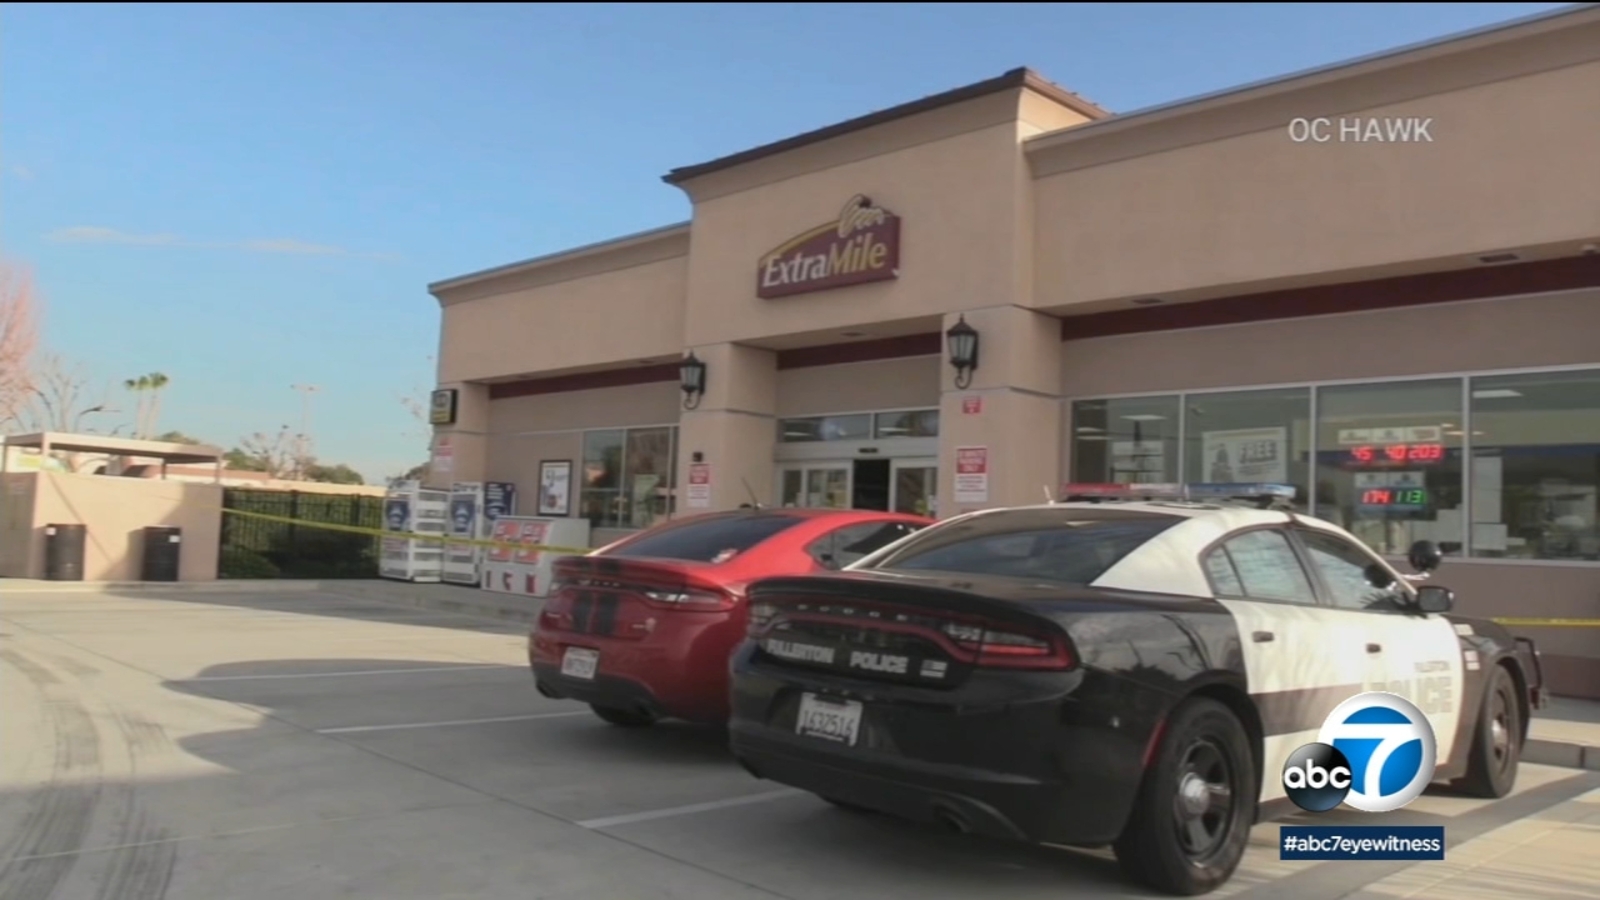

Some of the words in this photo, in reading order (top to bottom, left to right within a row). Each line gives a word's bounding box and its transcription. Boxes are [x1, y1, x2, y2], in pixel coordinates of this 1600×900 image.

[762, 233, 887, 288] ExtraMile
[1408, 444, 1444, 460] 203
[1362, 490, 1392, 504] 174
[1396, 490, 1424, 504] 113
[850, 651, 909, 674] POLICE
